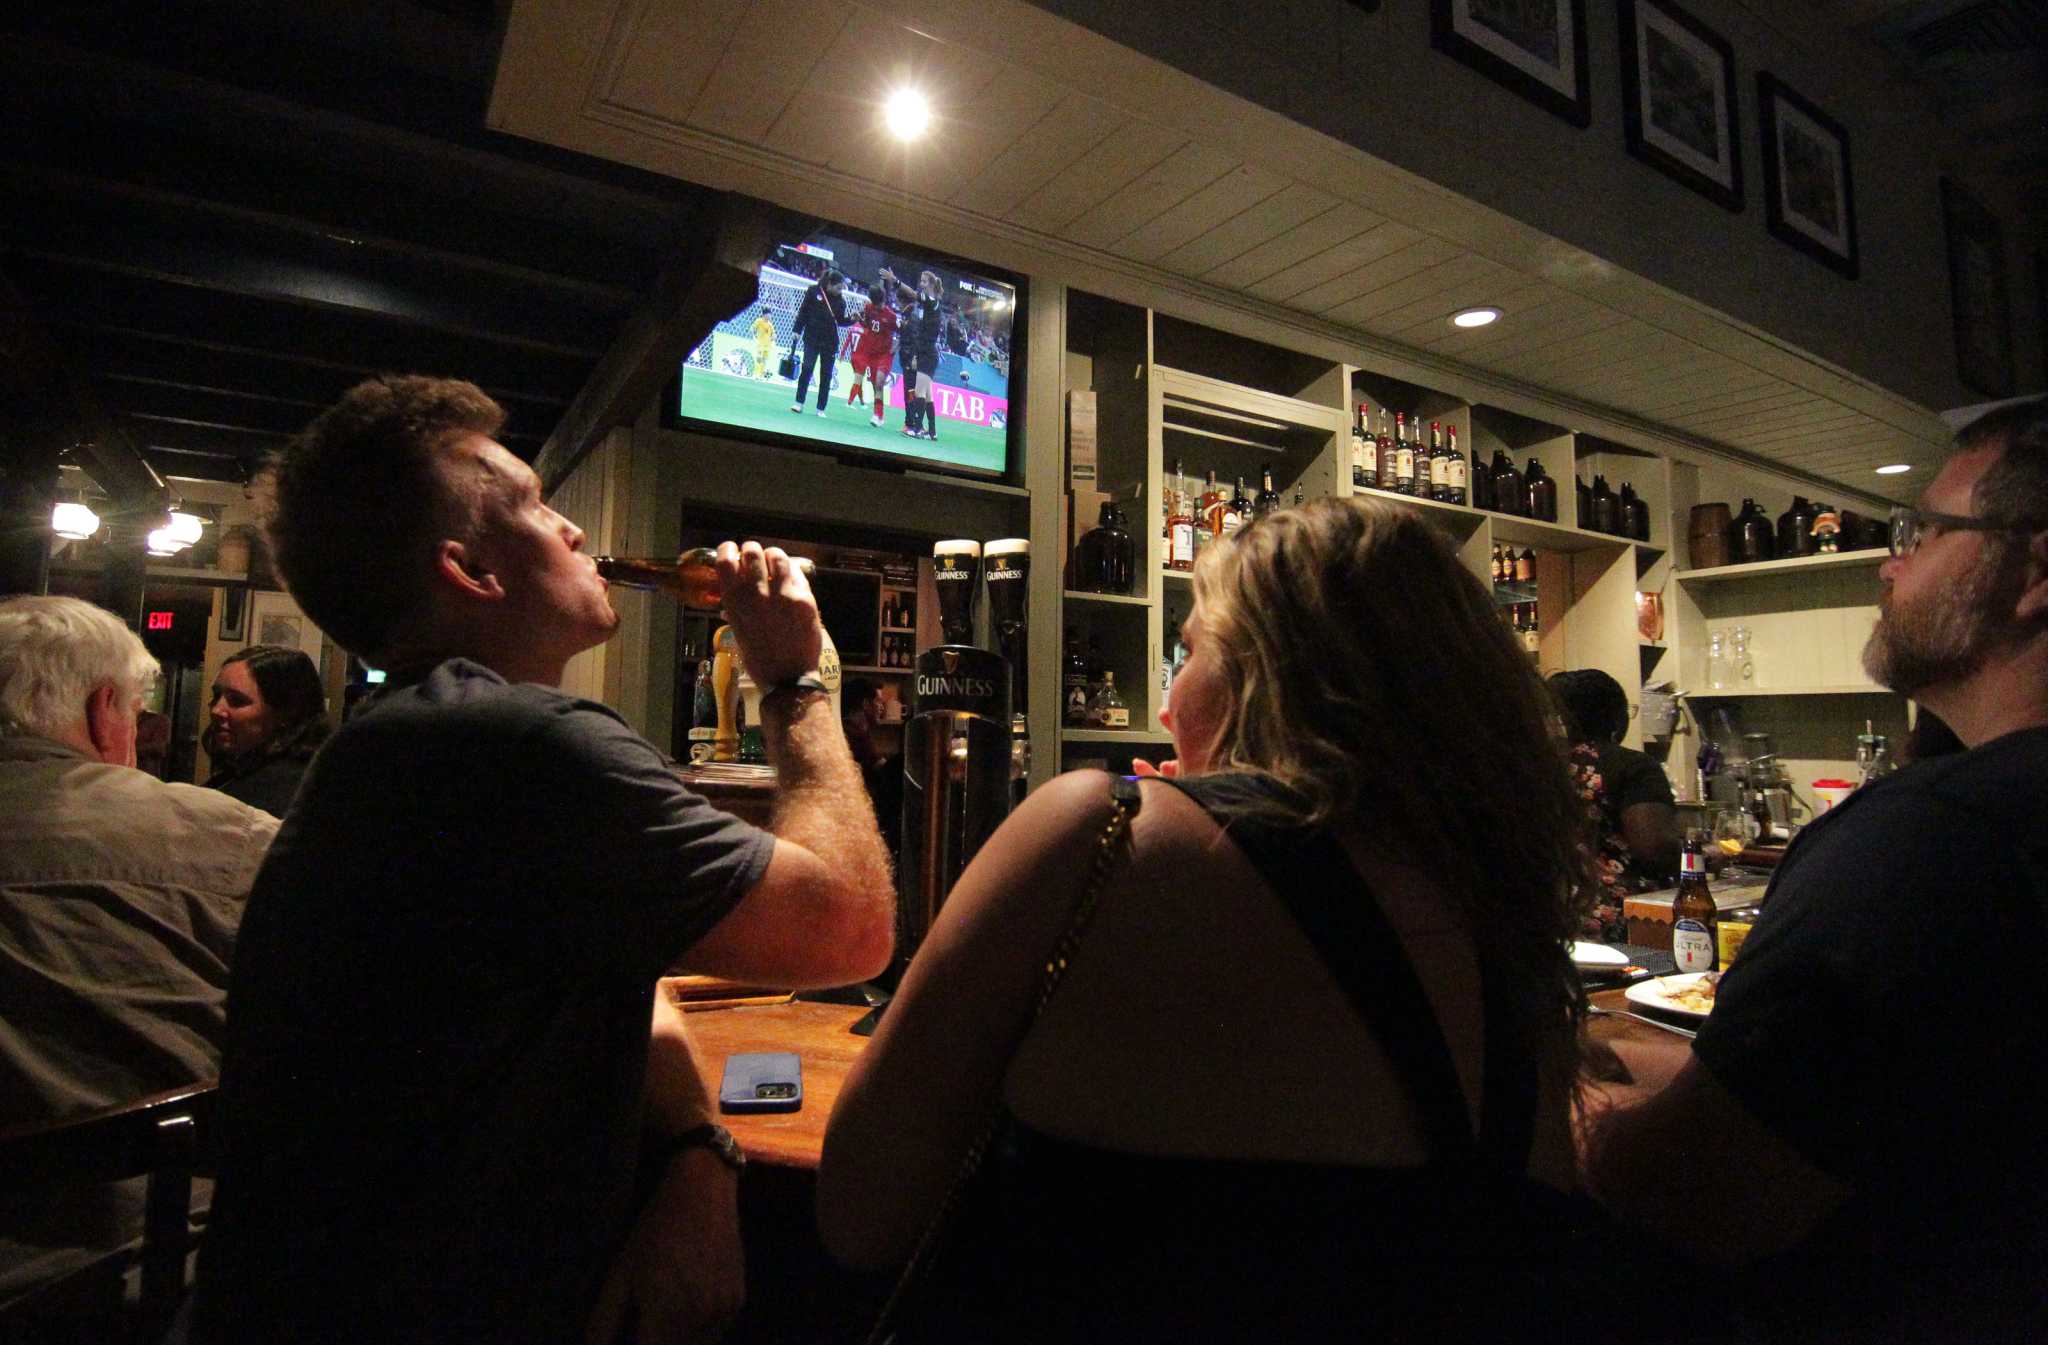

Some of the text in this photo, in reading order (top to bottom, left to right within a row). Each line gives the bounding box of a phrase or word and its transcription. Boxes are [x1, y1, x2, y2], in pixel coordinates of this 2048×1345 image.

[871, 319, 880, 332] 23
[936, 388, 985, 422] TAB
[935, 570, 968, 581] GUINNESS
[986, 569, 1022, 582] GUINNESS
[148, 612, 174, 630] EXIT
[917, 673, 993, 697] GUINNESS
